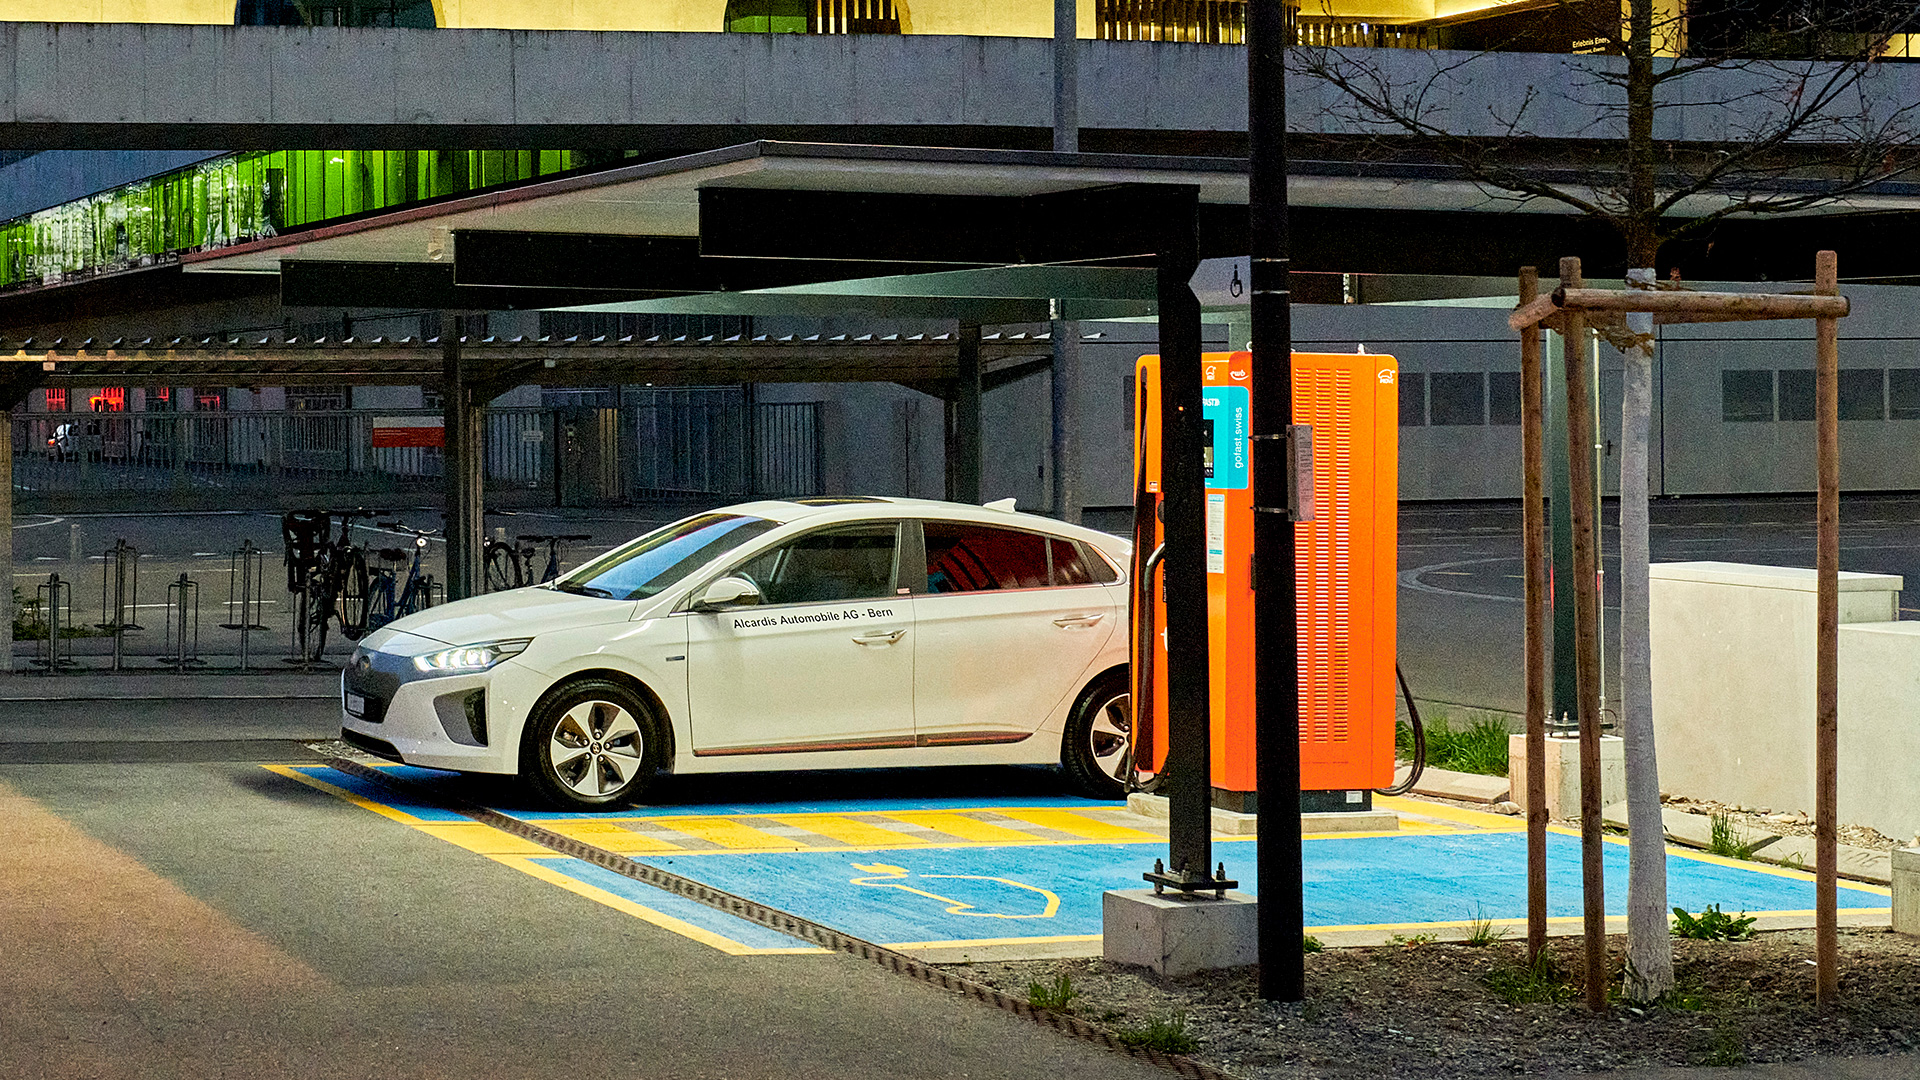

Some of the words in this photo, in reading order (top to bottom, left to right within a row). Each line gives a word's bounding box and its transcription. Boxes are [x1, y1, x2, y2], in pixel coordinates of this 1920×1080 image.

[1233, 406, 1244, 469] gofast.swiss
[733, 616, 777, 629] Alcardis
[780, 611, 840, 625] Automobile
[842, 609, 859, 620] AG
[867, 608, 894, 618] Bern
